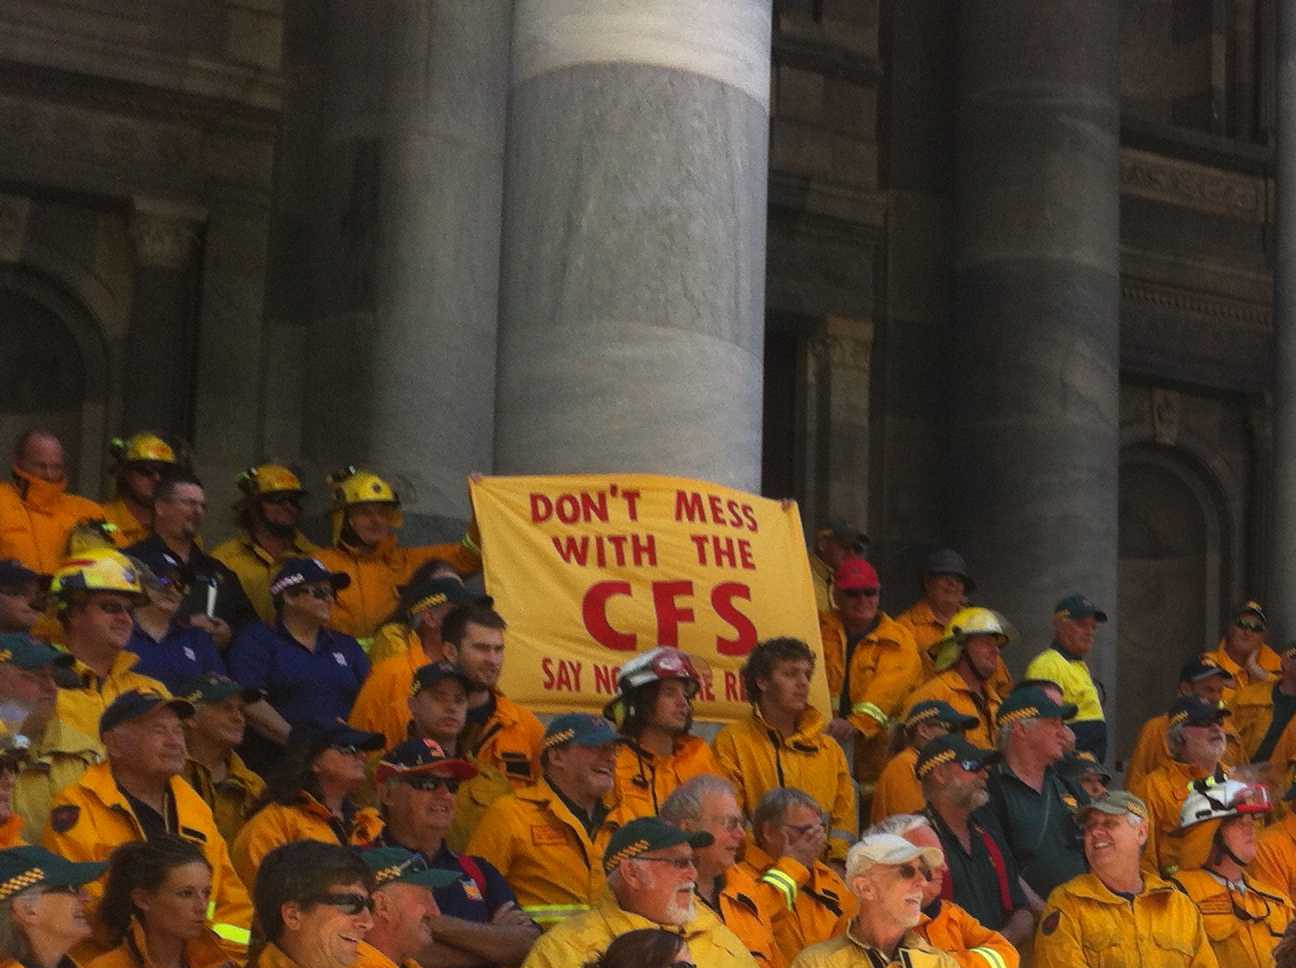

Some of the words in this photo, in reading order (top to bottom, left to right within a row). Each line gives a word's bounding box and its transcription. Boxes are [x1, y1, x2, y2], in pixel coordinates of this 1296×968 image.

[529, 483, 640, 524] DON'T
[674, 489, 759, 534] MESS
[552, 533, 658, 568] WITH
[690, 533, 757, 570] THE
[581, 579, 759, 657] CFS
[542, 656, 582, 692] SAY
